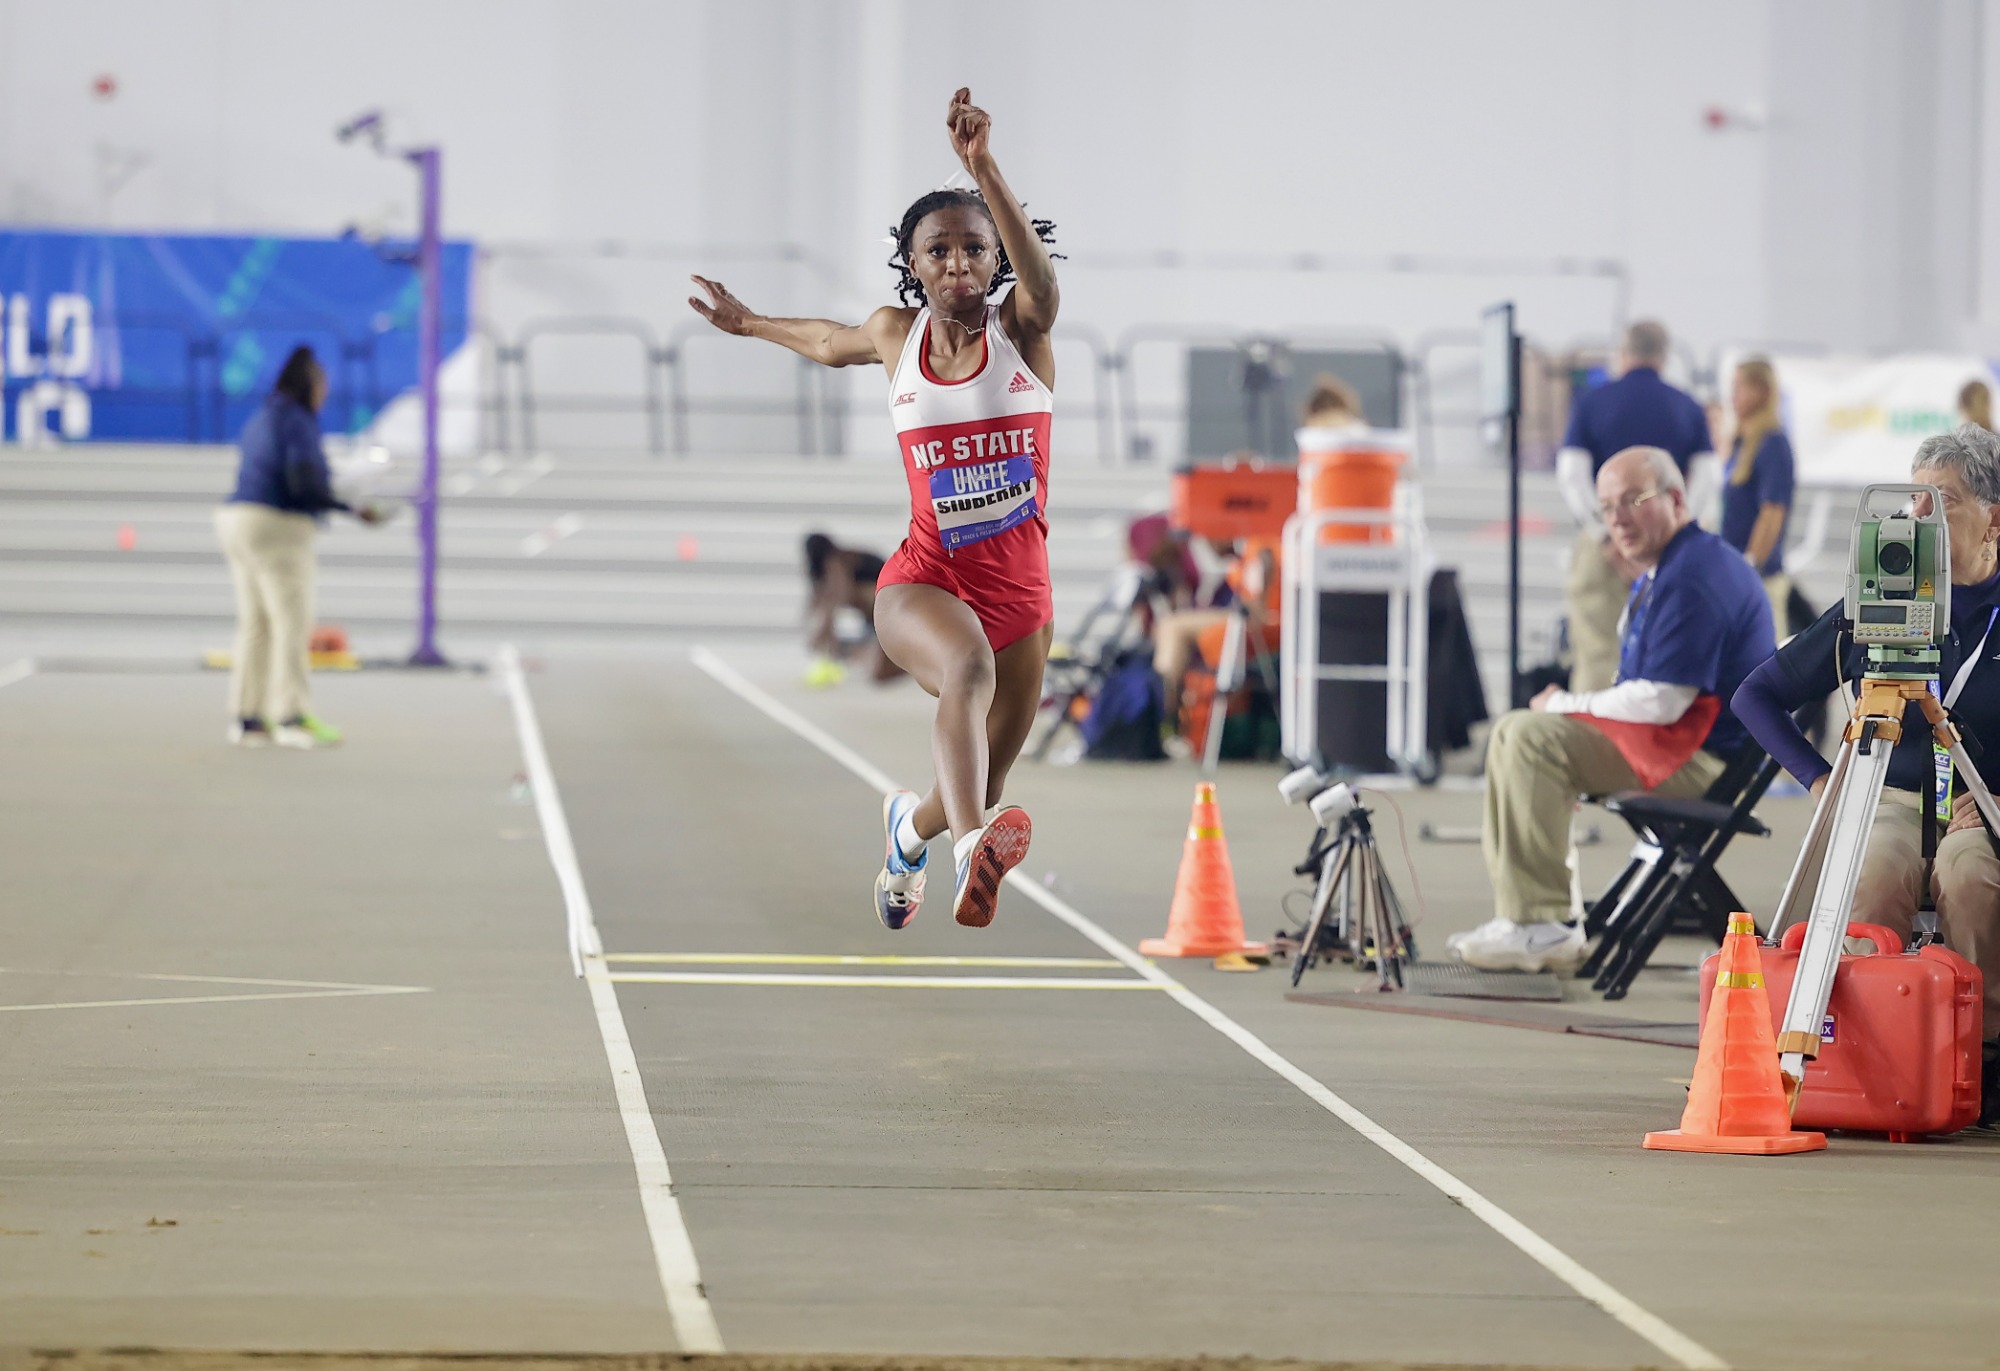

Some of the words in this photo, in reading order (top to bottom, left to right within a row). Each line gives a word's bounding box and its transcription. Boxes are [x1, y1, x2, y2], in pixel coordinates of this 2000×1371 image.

[0, 292, 92, 378] LD
[894, 392, 917, 405] ACC
[1009, 384, 1035, 394] adidas
[910, 440, 946, 469] NC
[952, 428, 1035, 461] STATE
[952, 460, 1011, 494] UNITE
